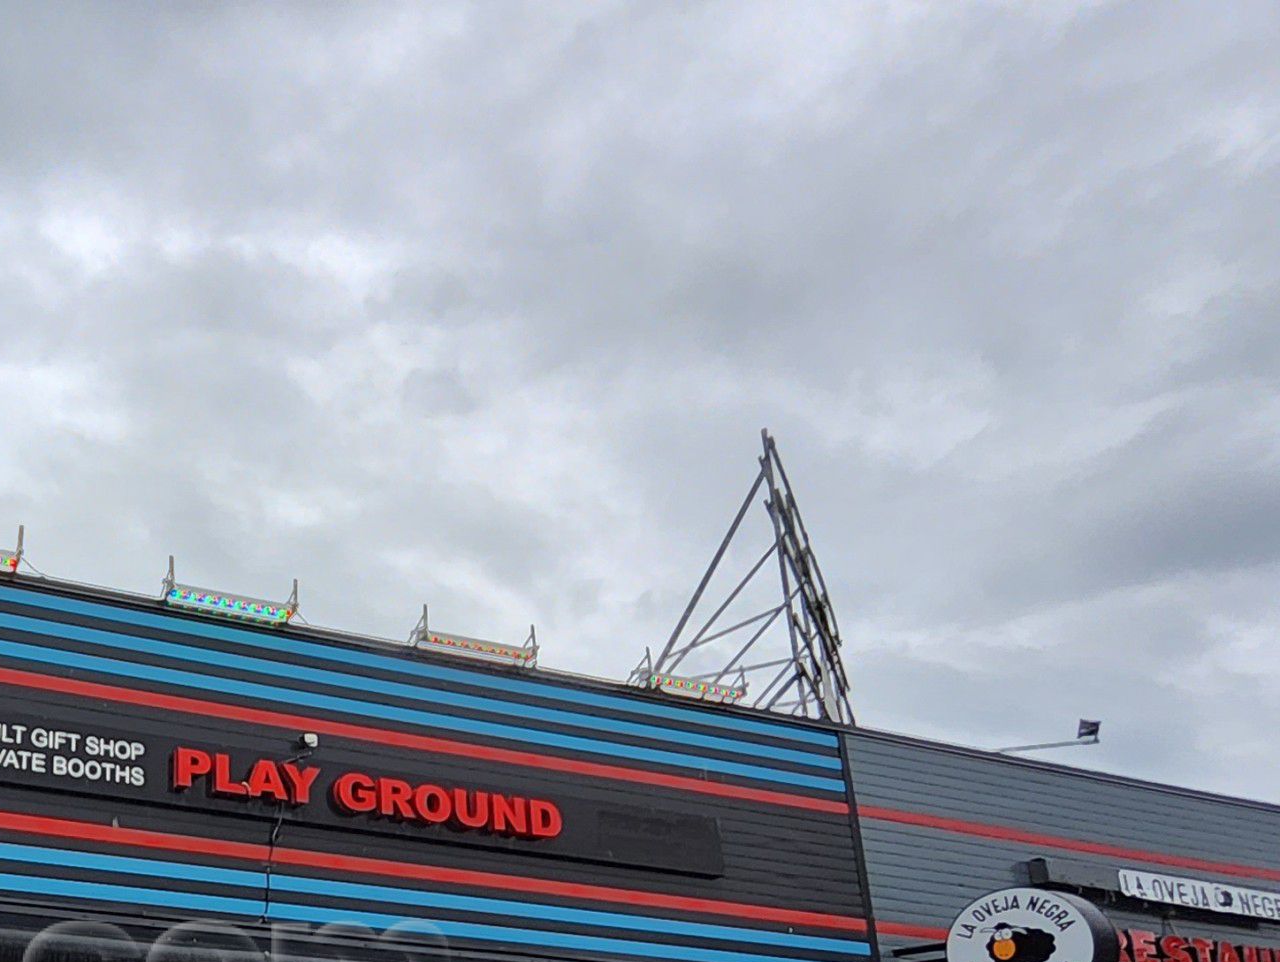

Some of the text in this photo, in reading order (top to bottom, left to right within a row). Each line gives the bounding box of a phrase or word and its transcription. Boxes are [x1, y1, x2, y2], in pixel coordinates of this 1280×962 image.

[30, 727, 81, 752] GIFT
[85, 736, 146, 761] SHOP
[52, 755, 146, 786] BOOTHS
[173, 746, 563, 839] PLAY GROUND
[1122, 873, 1148, 897] LA
[1151, 878, 1211, 908] OVEJA
[956, 894, 1076, 939] LA OVEJA NEGRA
